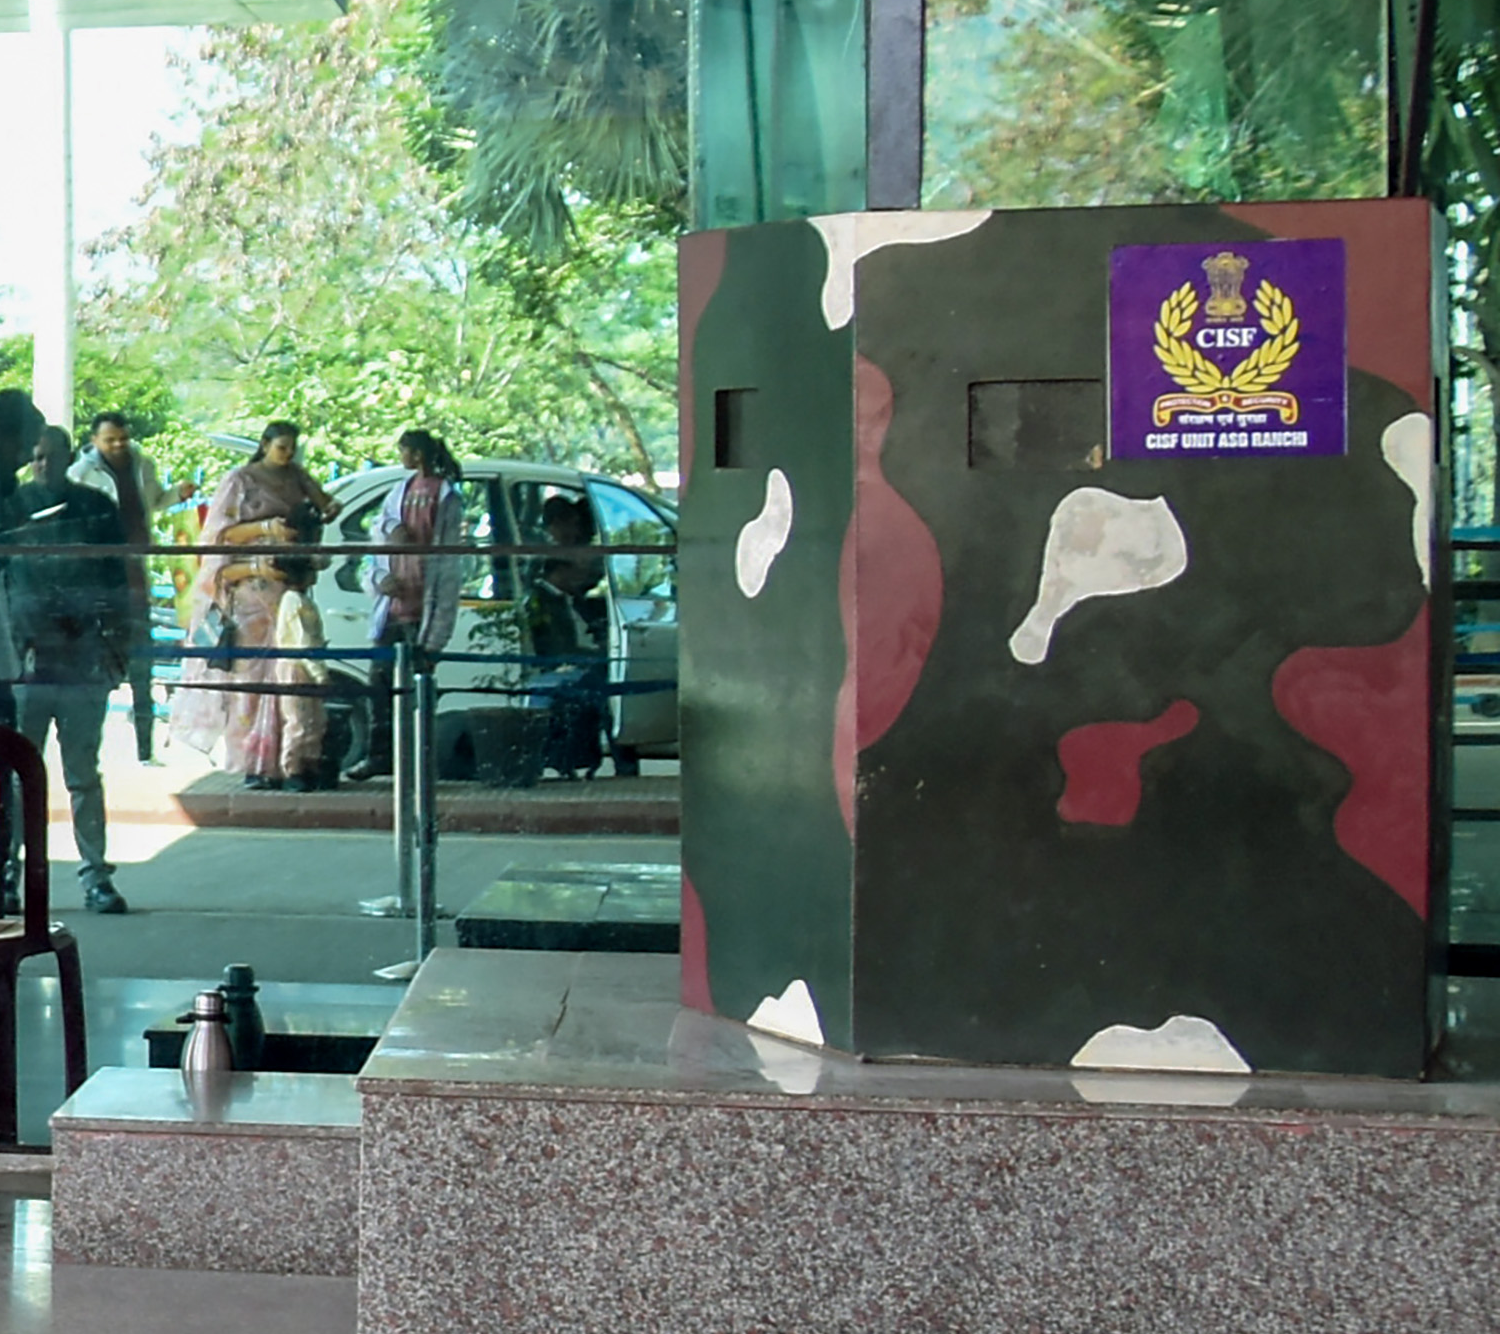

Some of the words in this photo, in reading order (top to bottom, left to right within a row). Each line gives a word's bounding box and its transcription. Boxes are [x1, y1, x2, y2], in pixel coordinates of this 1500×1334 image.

[1196, 327, 1257, 348] CISF
[1146, 432, 1178, 449] CISF
[1182, 432, 1216, 448] UNIT
